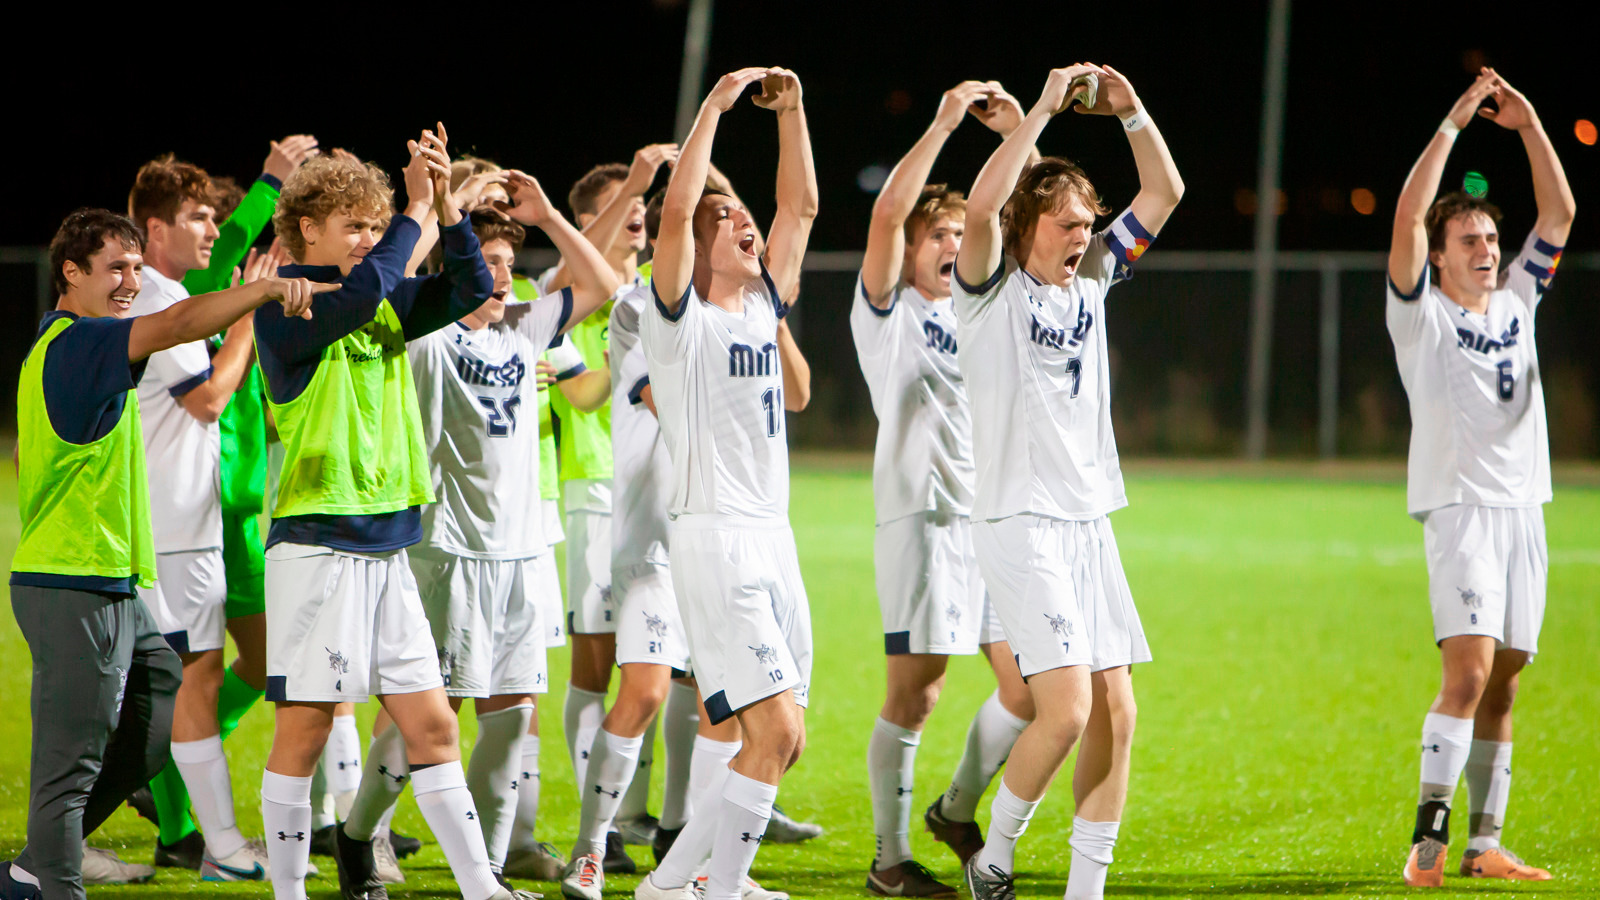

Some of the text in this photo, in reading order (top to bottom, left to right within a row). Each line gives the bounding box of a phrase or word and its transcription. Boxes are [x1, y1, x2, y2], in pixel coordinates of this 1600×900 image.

[1065, 356, 1083, 399] 7
[1496, 359, 1515, 403] 6
[1062, 641, 1070, 655] 7
[768, 668, 784, 684] 10
